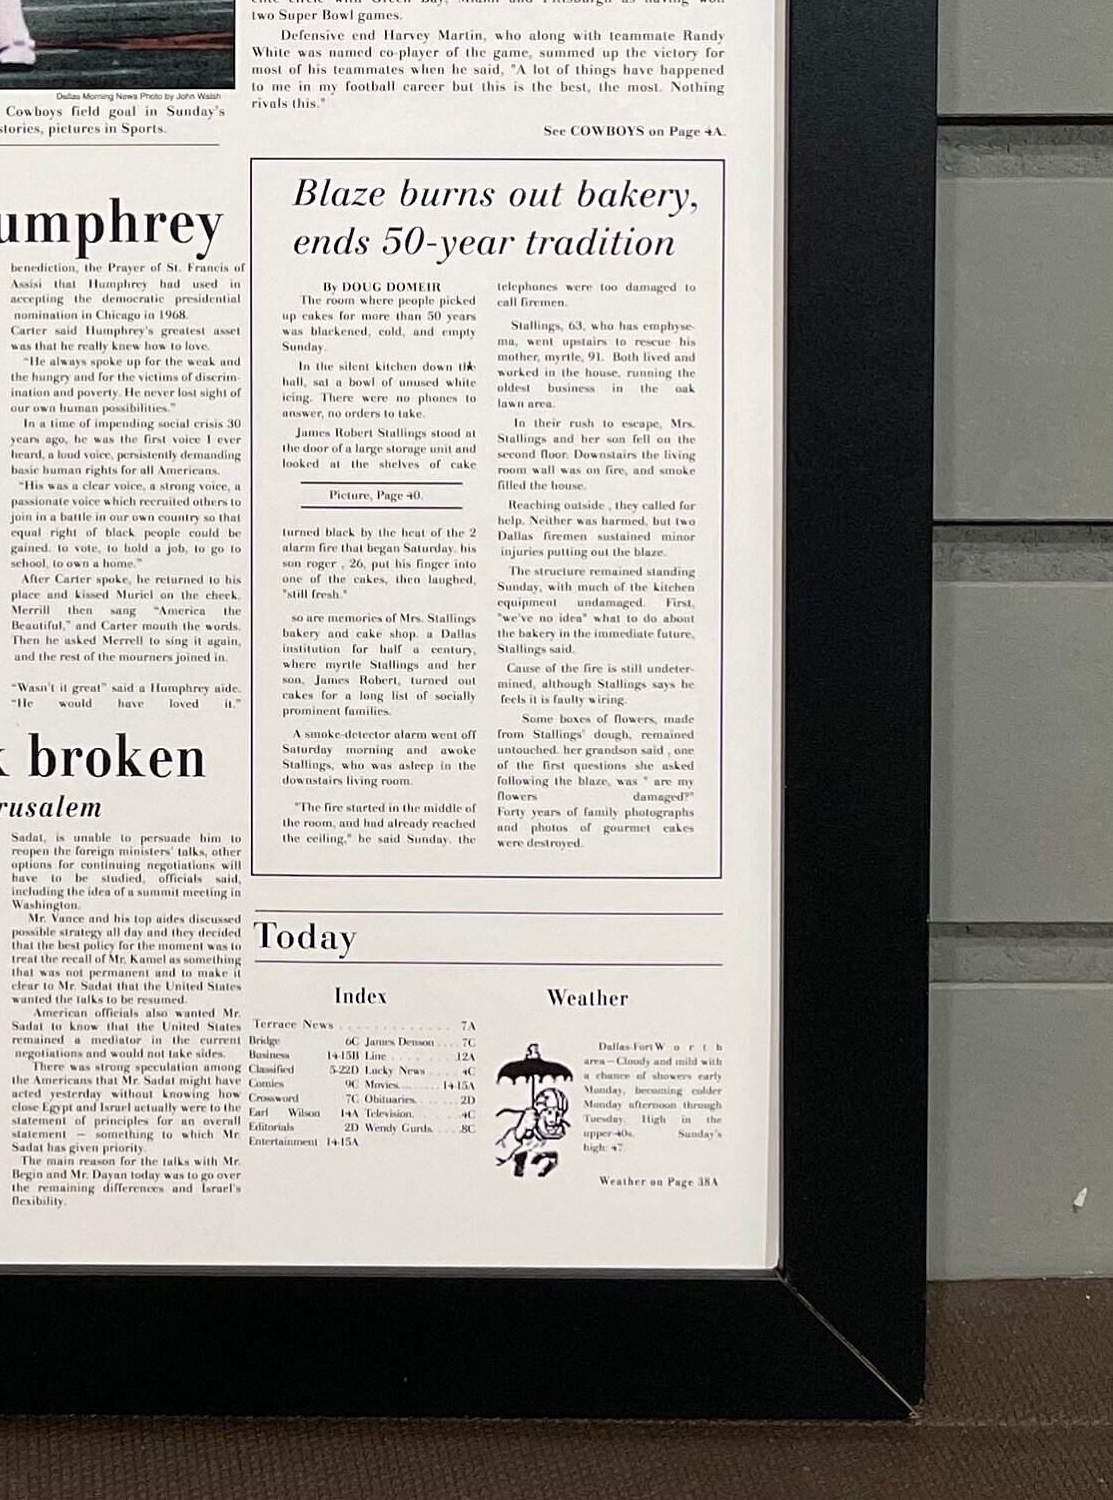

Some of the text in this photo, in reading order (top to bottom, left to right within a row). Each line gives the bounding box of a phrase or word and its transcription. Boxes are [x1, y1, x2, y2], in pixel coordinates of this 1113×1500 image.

[251, 11, 275, 21] two
[278, 8, 319, 25] Super
[322, 9, 354, 21] Bowl
[5, 105, 63, 121] Cowboys
[71, 105, 100, 117] field
[108, 105, 137, 121] goal
[145, 105, 158, 117] in
[166, 105, 226, 121] Sunday’s
[543, 125, 567, 137] See
[570, 125, 645, 137] COWBOYS
[648, 129, 665, 137] on
[669, 125, 701, 140] Page
[292, 178, 698, 219] Blaze burns out bakery,
[293, 226, 675, 265] ends 50-year tradition
[323, 281, 441, 295] By DOUG DOMEIR
[28, 733, 205, 778] broken
[253, 921, 357, 960] Today
[335, 986, 387, 1005] Index
[547, 988, 629, 1007] Weather
